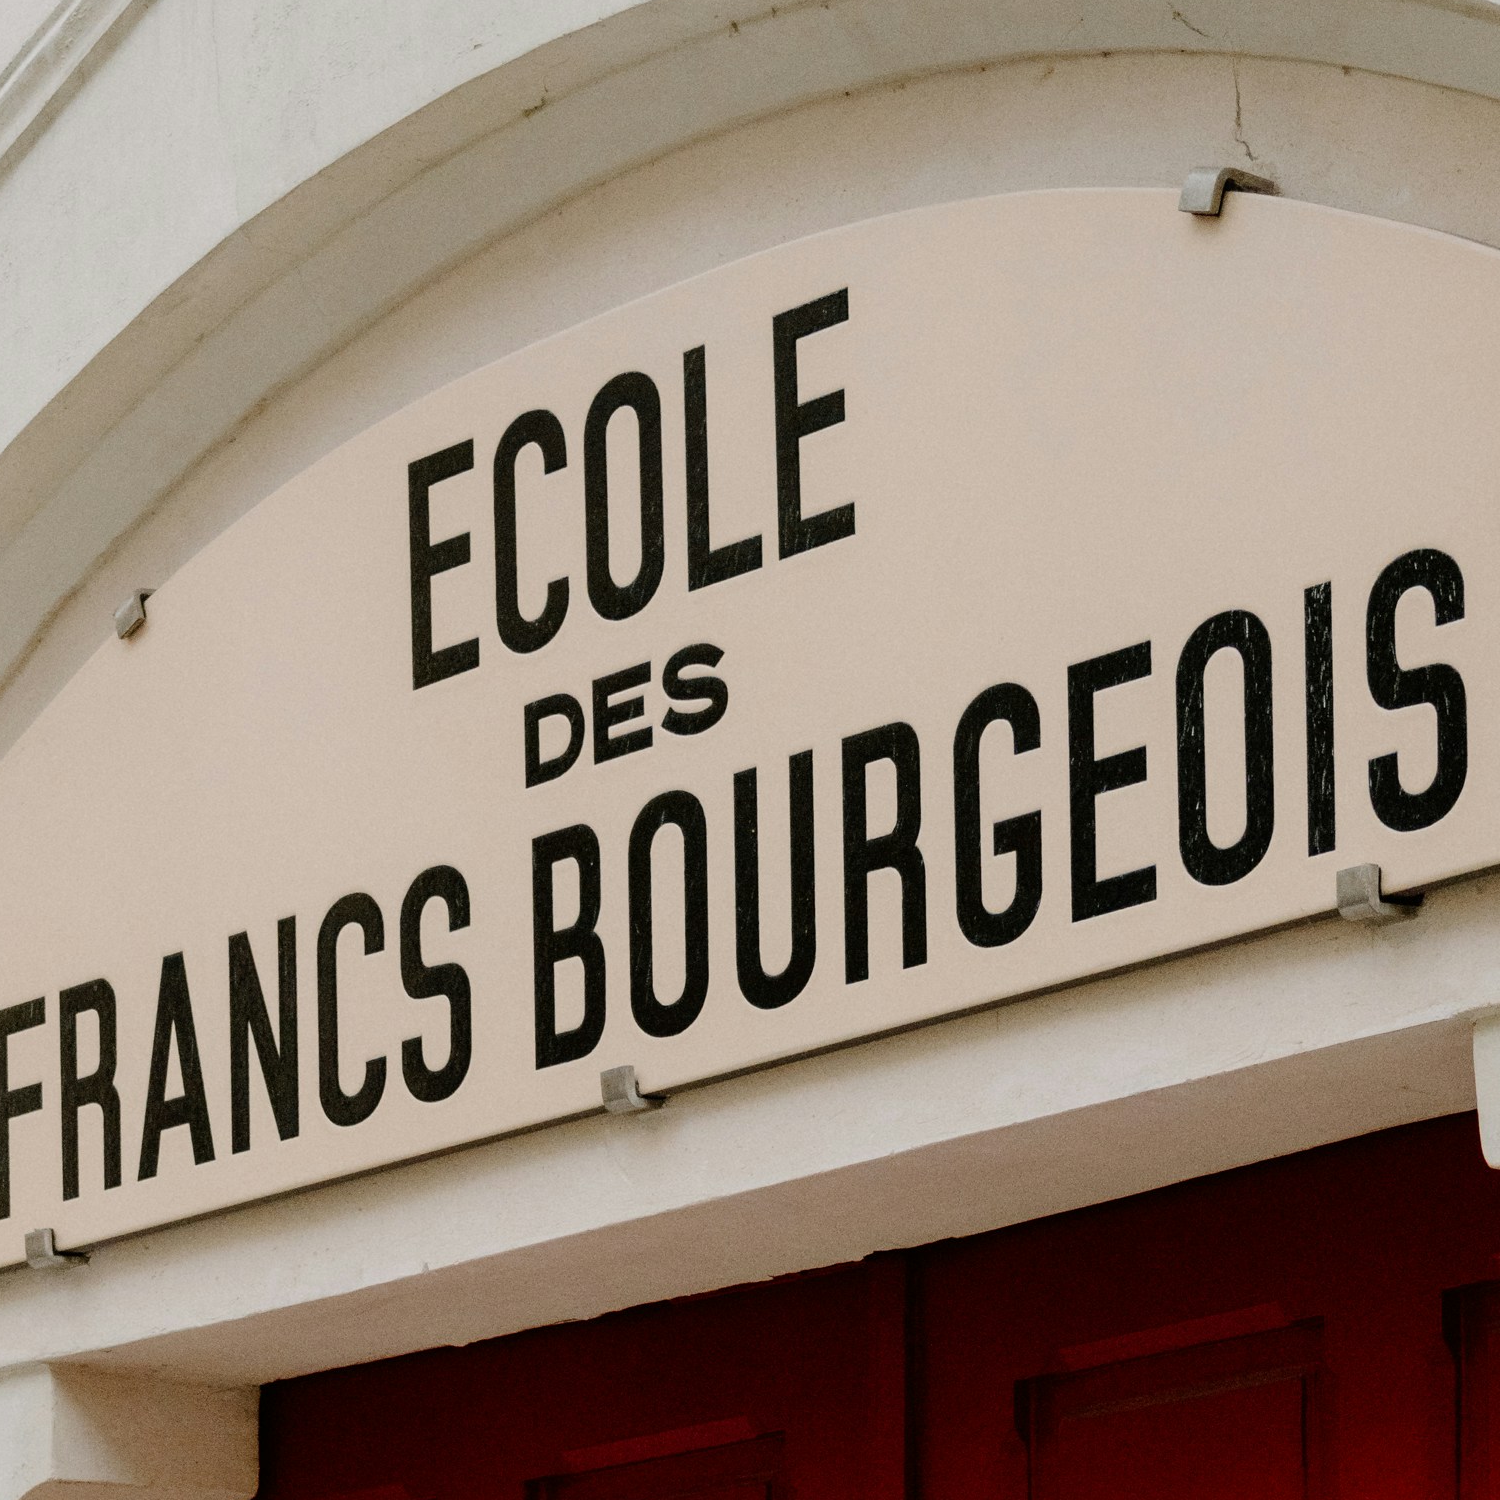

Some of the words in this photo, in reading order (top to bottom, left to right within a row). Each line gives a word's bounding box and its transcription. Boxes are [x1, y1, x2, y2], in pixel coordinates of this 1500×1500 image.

[406, 285, 857, 692] ECOLE
[522, 641, 730, 790] DES
[530, 547, 1470, 1072] BOURGEOIS
